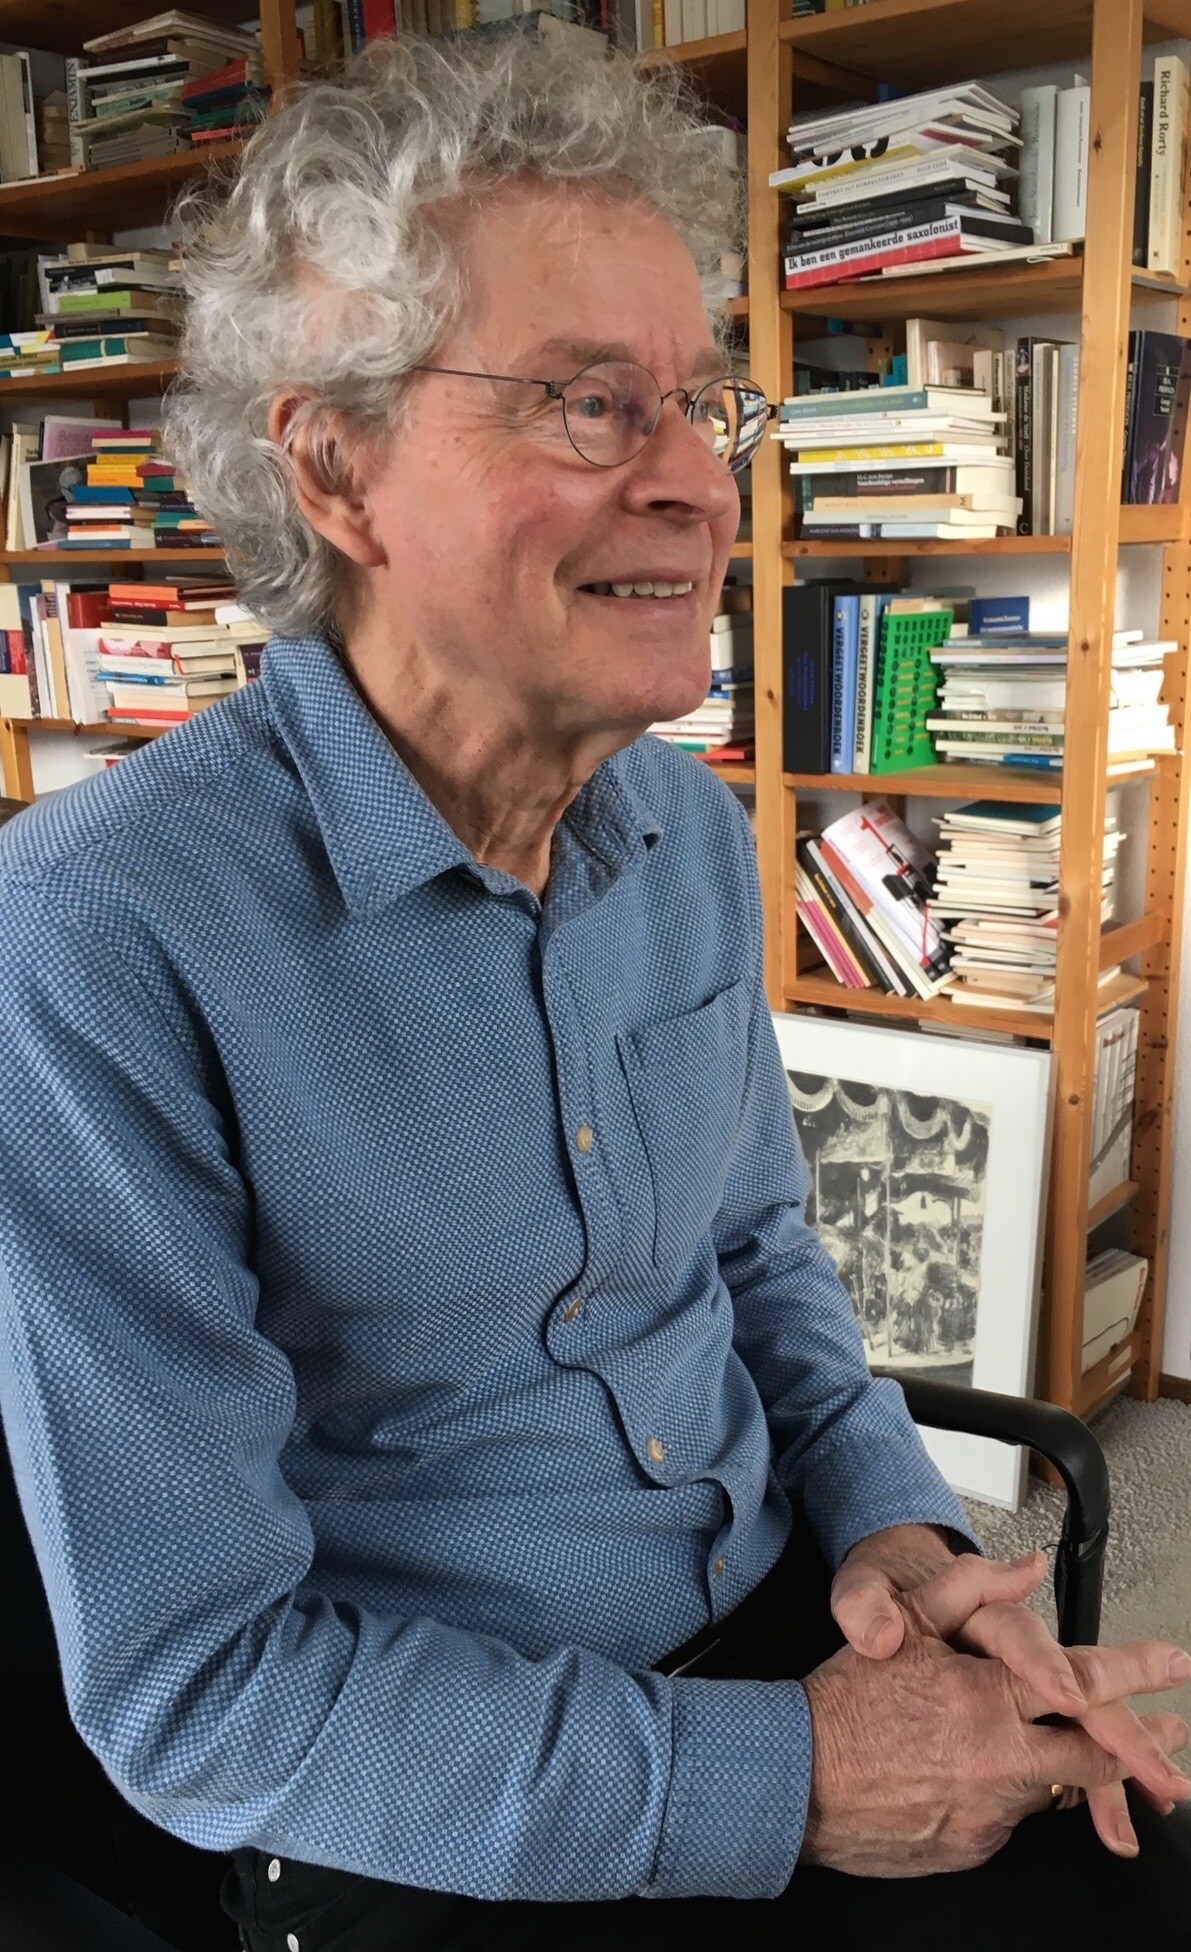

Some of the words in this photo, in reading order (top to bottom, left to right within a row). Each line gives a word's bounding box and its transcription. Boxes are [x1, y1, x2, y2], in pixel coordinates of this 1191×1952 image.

[1159, 70, 1171, 119] Richard
[1155, 122, 1169, 156] Rorty
[788, 258, 798, 269] Ik
[801, 254, 818, 267] ben
[820, 250, 837, 262] een
[839, 232, 904, 260] gemankeerde
[907, 219, 958, 241] saxofonist
[833, 626, 844, 755] VERGEETWOORDENBOEK
[856, 626, 869, 755] VERGEETWOORDENBOEK
